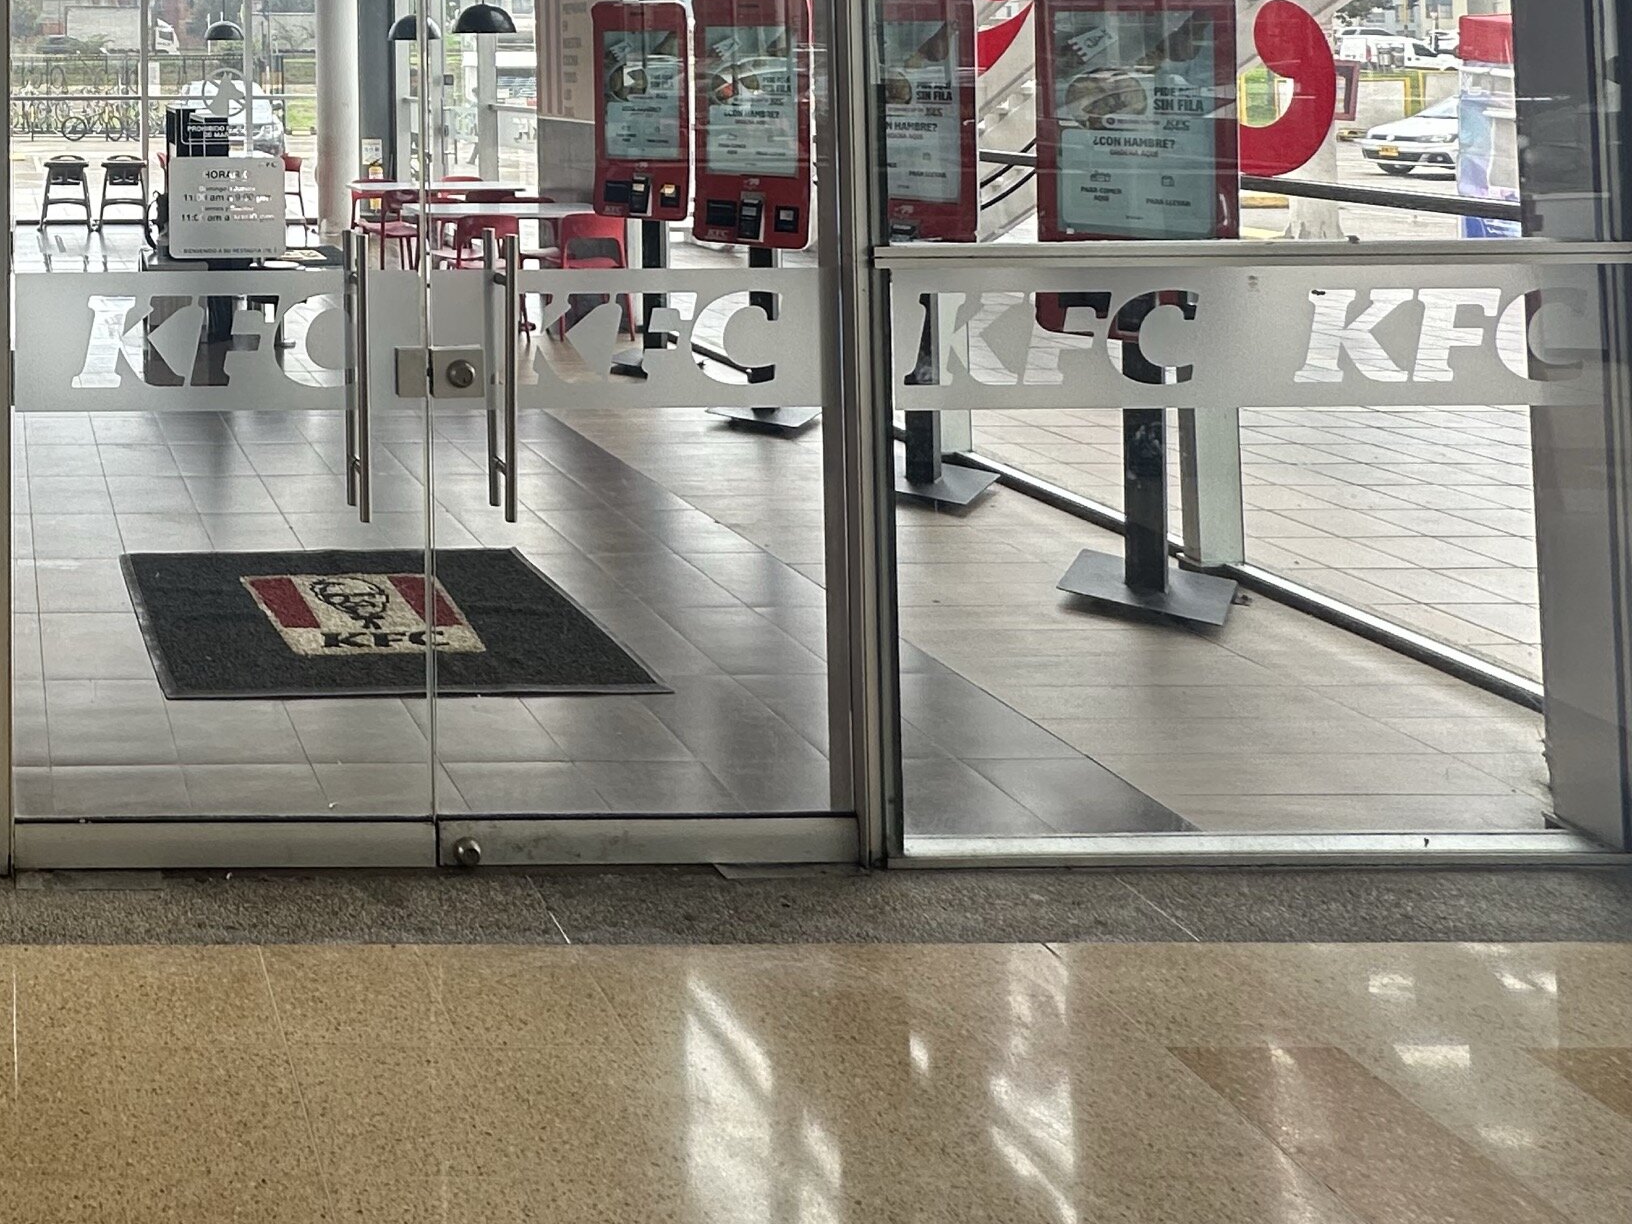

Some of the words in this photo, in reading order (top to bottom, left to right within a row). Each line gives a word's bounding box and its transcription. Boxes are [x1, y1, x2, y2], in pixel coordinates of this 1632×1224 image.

[916, 90, 932, 101] SIN
[933, 91, 953, 102] FILA
[1153, 98, 1174, 111] SIN
[1176, 99, 1204, 112] FILA
[894, 121, 938, 132] HAMBRE?
[1092, 136, 1121, 147] ¿CON
[1123, 137, 1176, 149] HAMBRE?
[71, 292, 360, 388] KFC
[494, 290, 783, 386] KFC
[903, 289, 1200, 386] KFC
[1293, 286, 1589, 382] KFC
[320, 628, 451, 650] KFC
